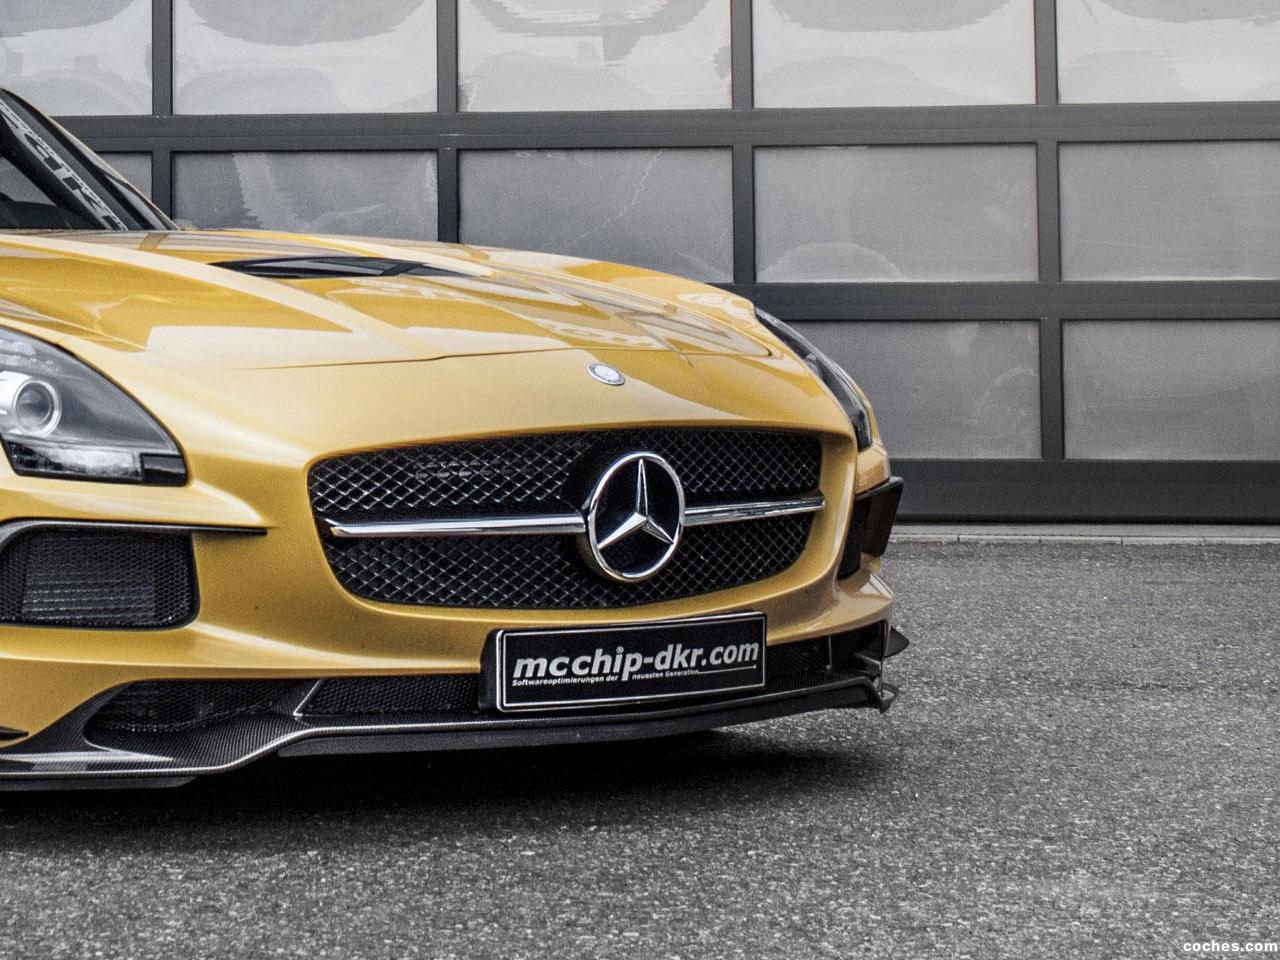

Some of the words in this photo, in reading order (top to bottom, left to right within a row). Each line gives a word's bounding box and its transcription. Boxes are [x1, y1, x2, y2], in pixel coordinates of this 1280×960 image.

[511, 674, 605, 687] Softwareoptimierungen
[606, 674, 619, 683] der
[632, 671, 664, 680] neuesten
